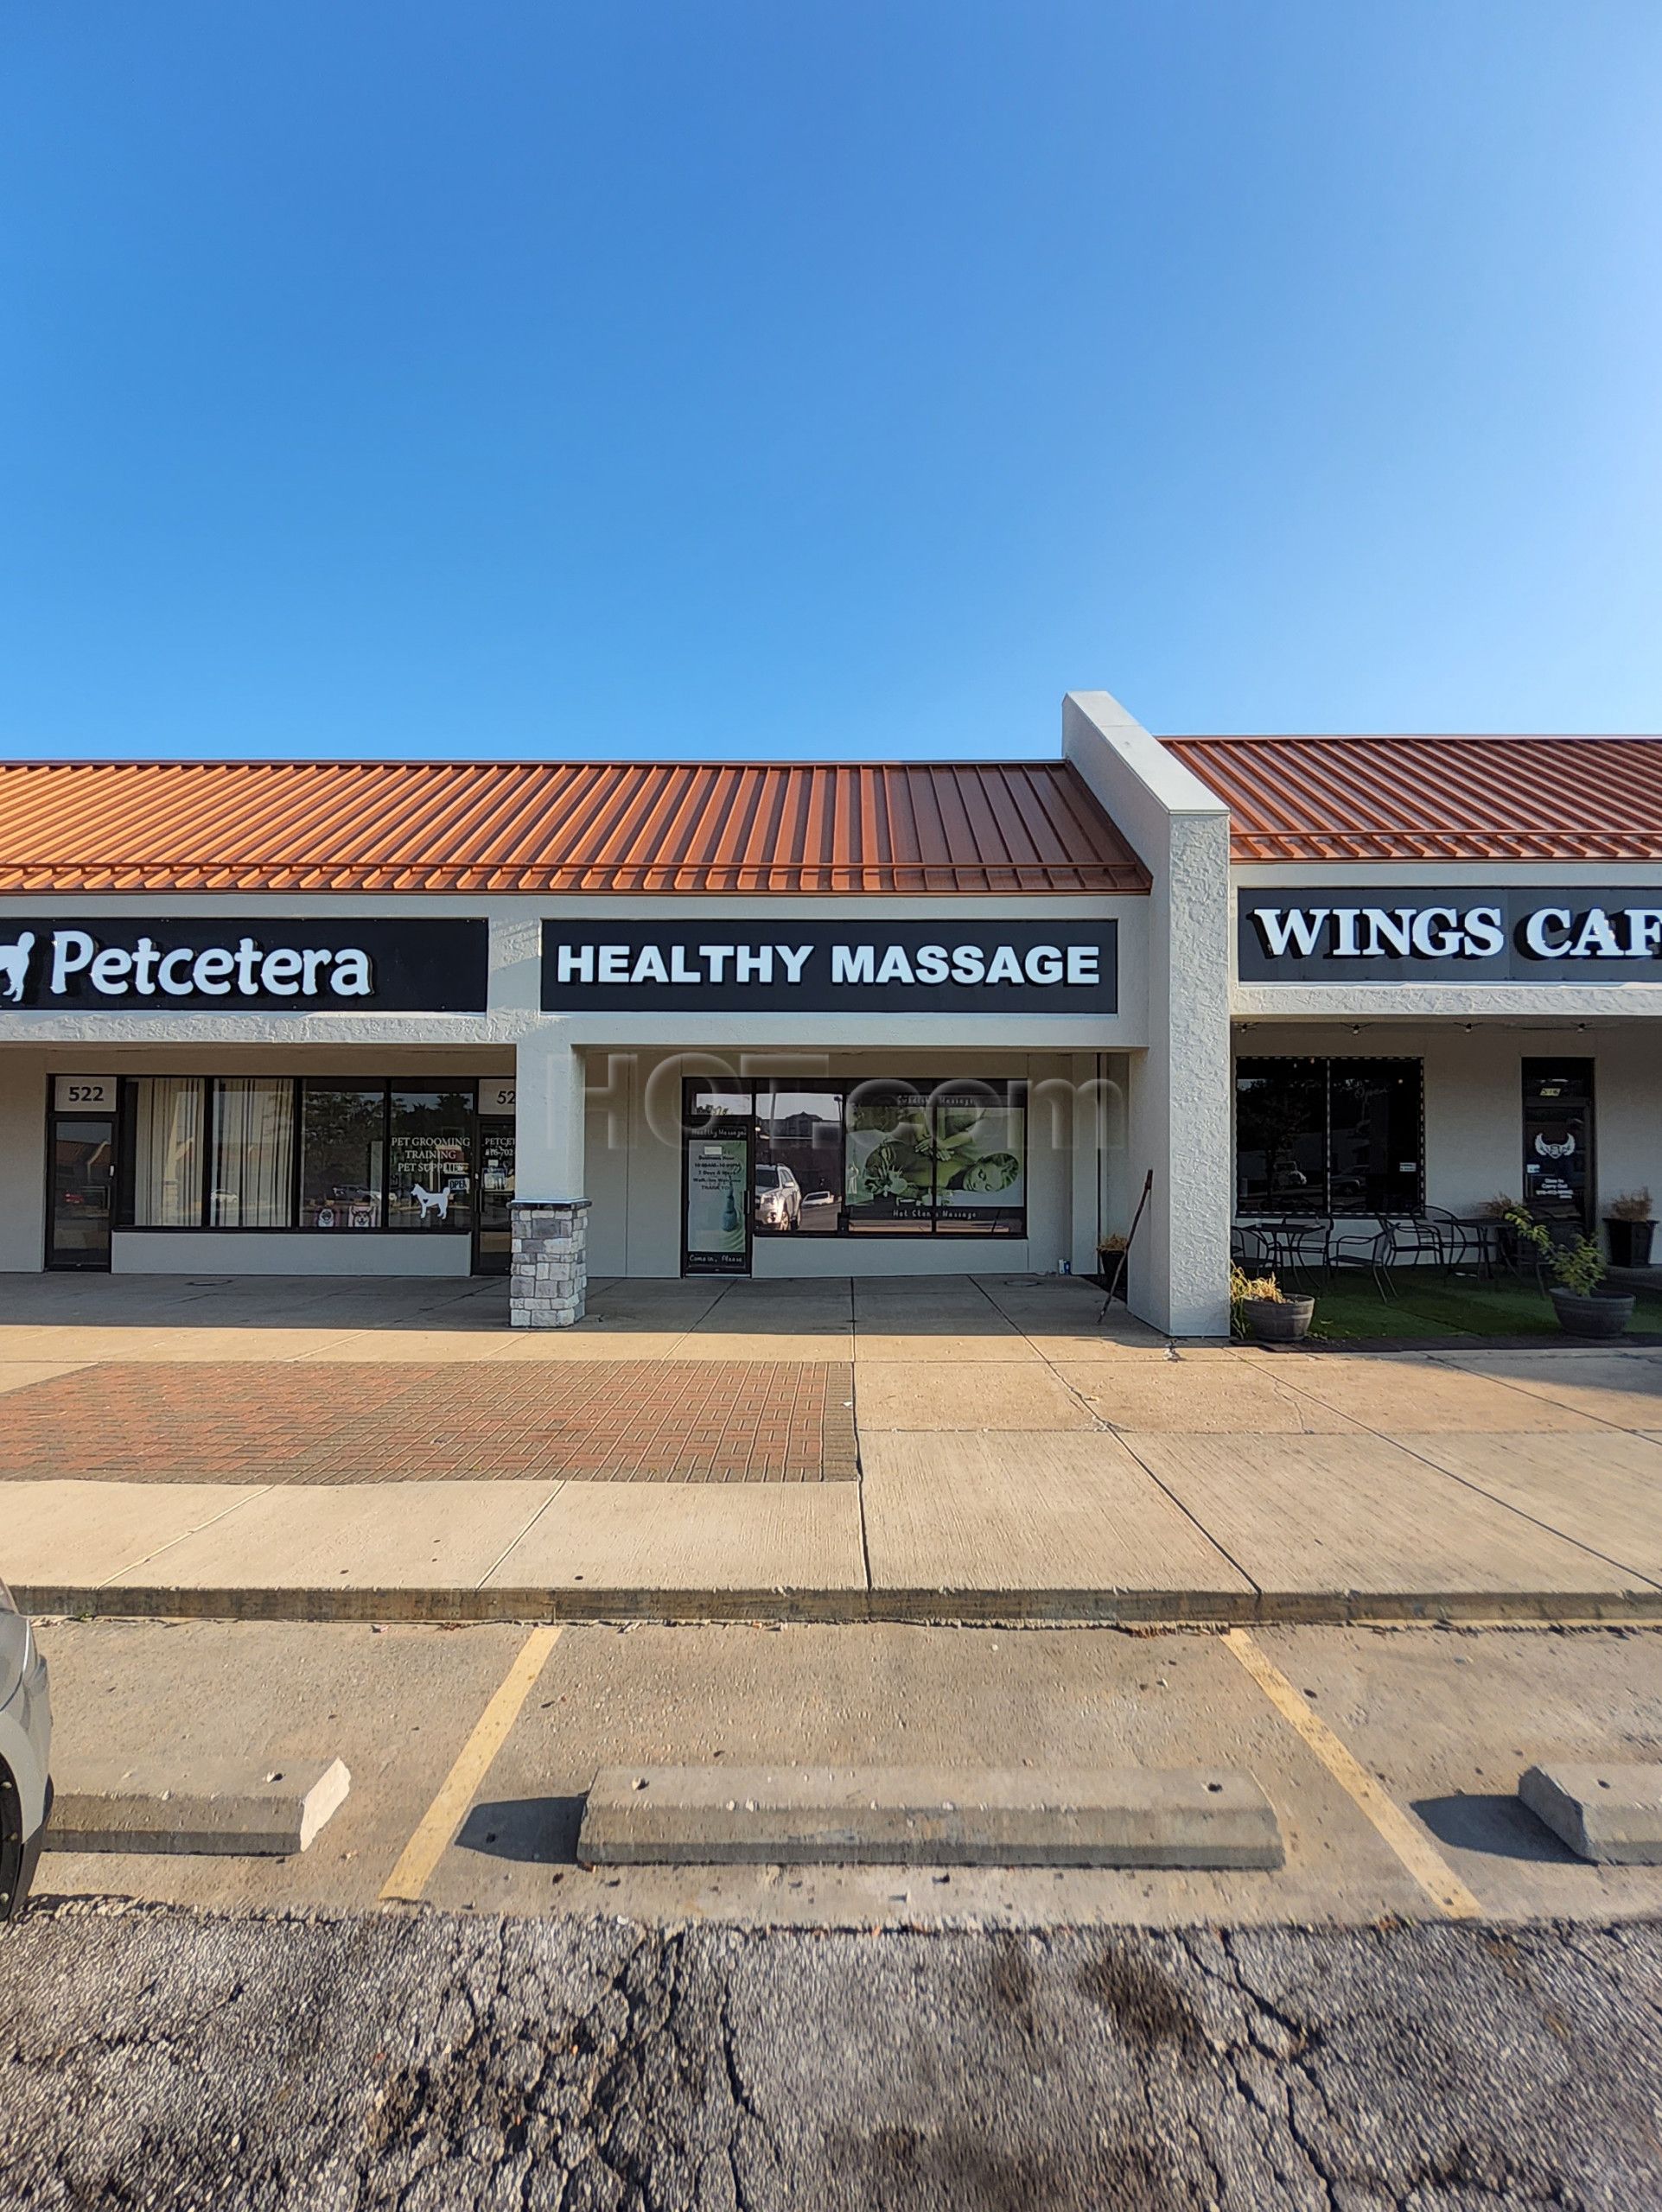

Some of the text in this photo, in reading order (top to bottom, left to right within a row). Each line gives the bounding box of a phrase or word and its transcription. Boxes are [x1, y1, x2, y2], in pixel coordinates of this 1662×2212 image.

[1253, 907, 1504, 956] WINGS
[50, 931, 372, 995] Petcetera
[557, 945, 1100, 984] HEALTHY MASSAGE
[68, 1086, 104, 1102] 522
[392, 1137, 471, 1147] PET GROOMING
[404, 1150, 457, 1159] TRAINING
[398, 1163, 417, 1173] PET
